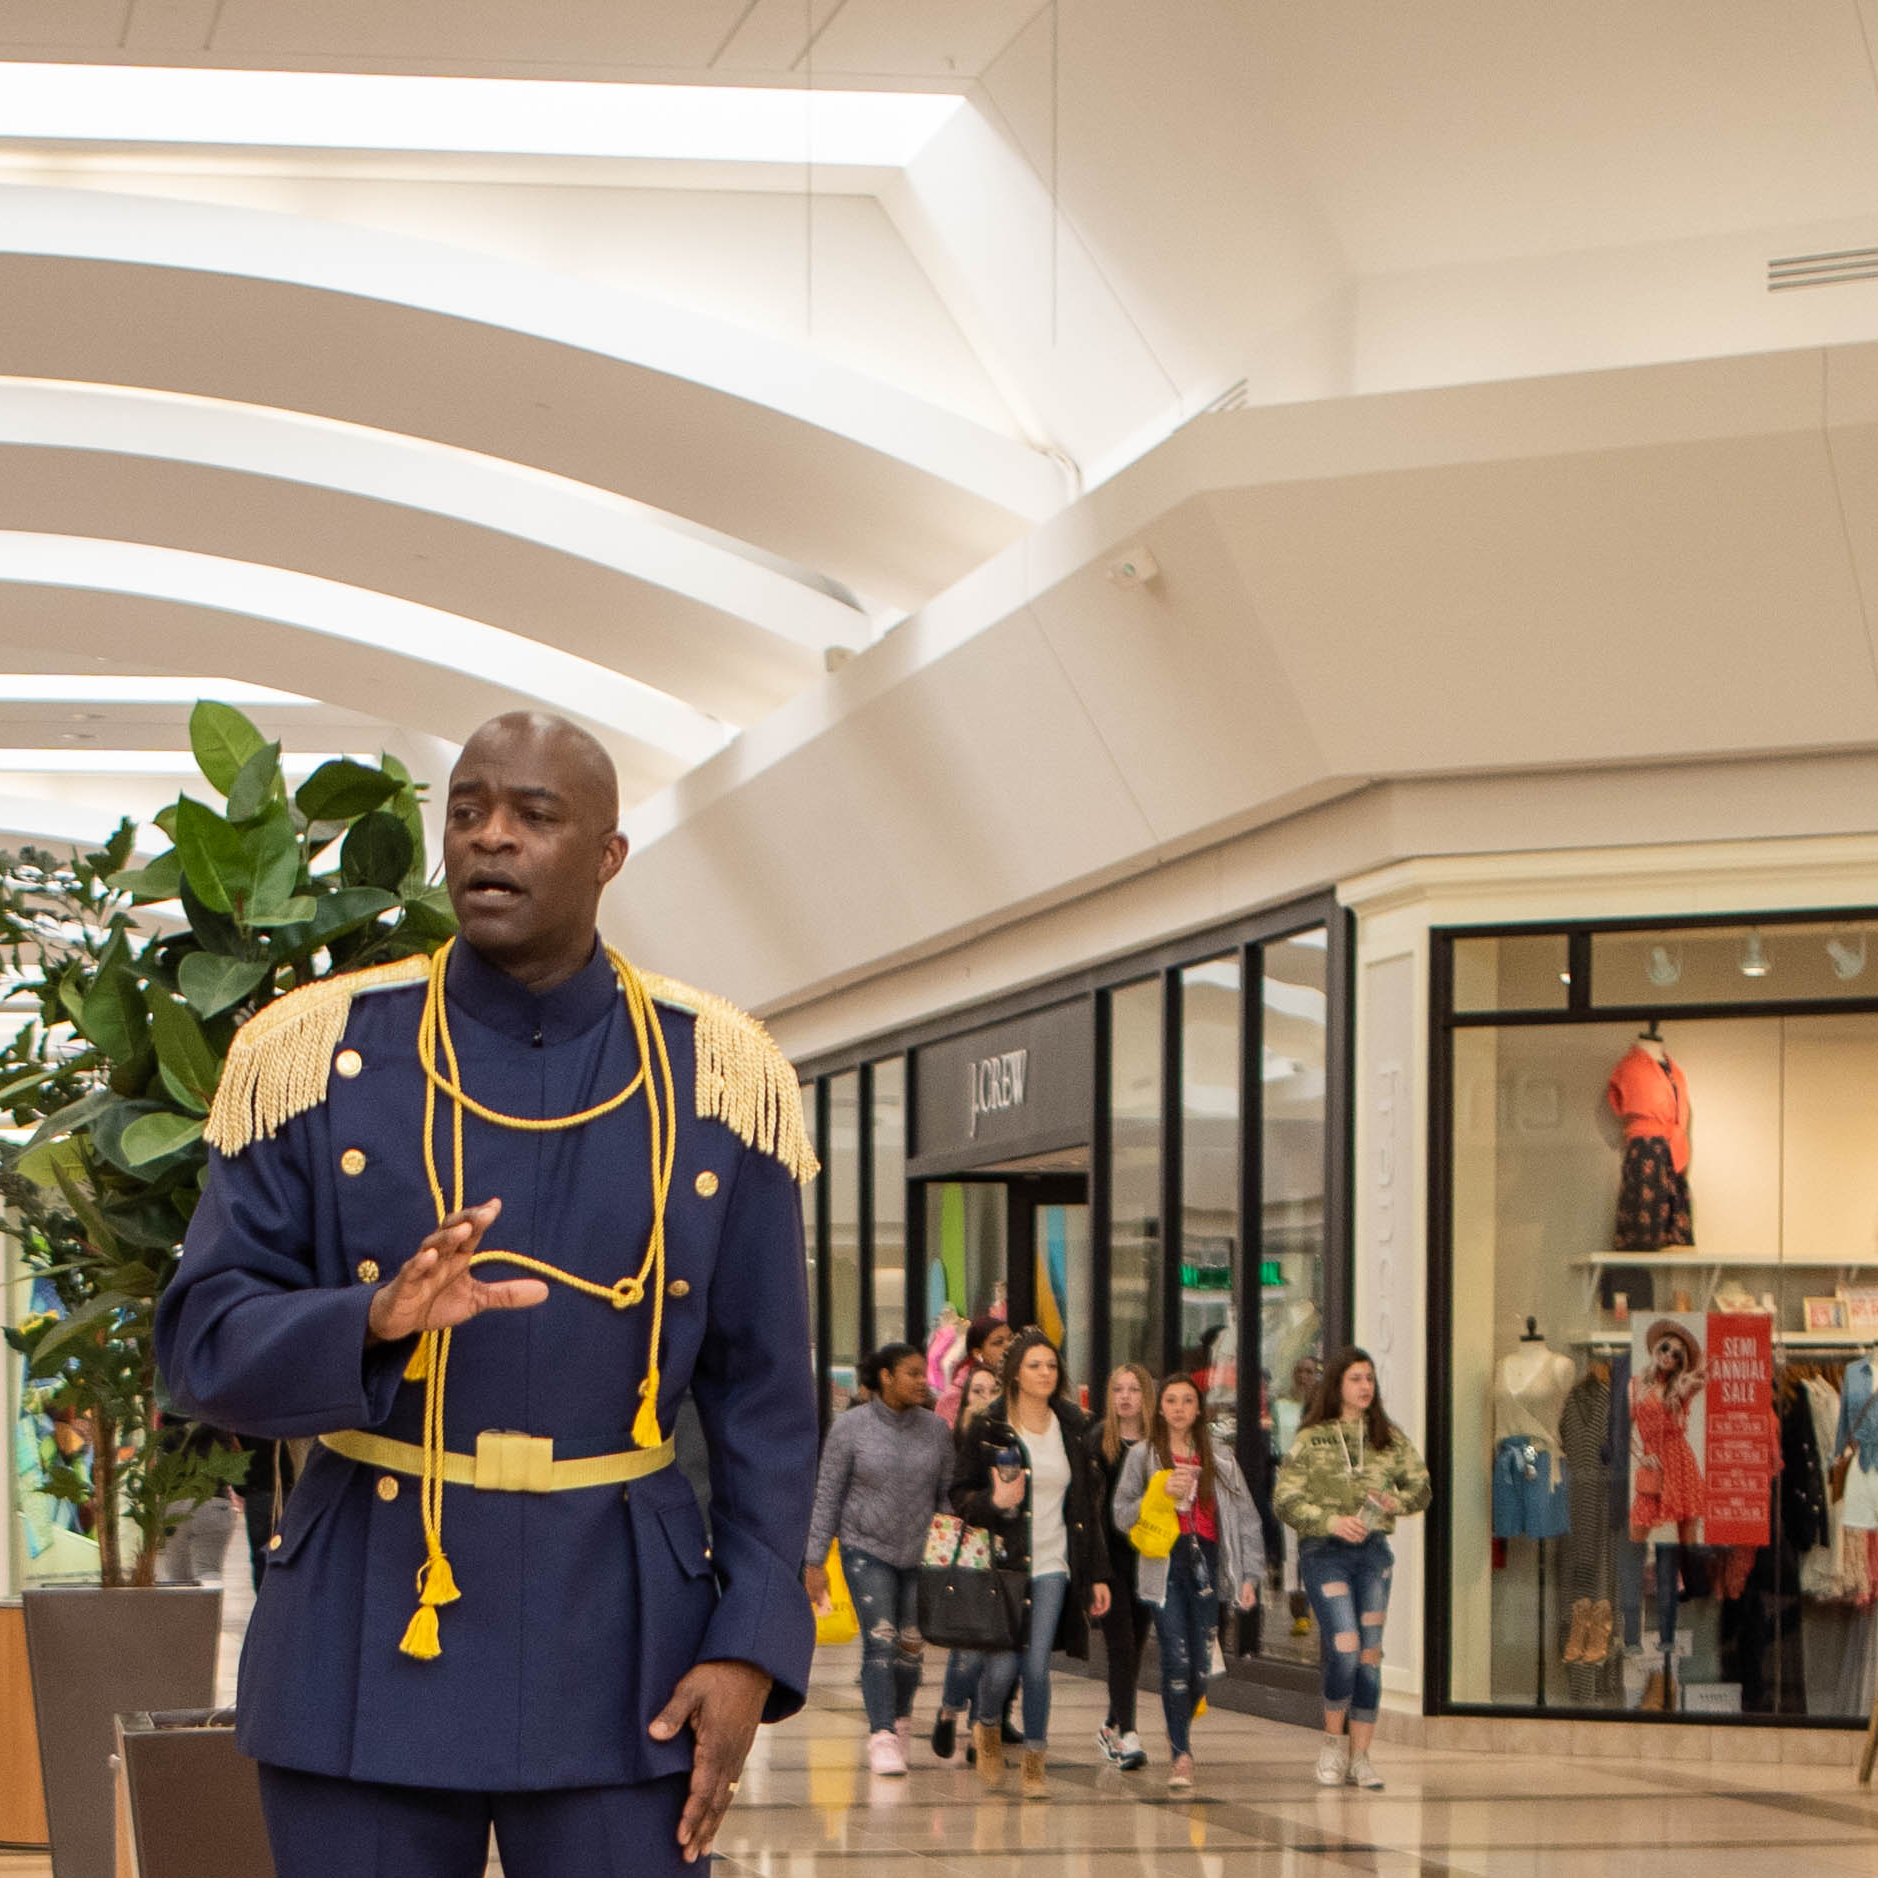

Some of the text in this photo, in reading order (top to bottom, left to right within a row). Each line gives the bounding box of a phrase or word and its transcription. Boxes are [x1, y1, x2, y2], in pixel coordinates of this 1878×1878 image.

[969, 1049, 1027, 1137] J.CREW
[1723, 1336, 1757, 1358] SEMI
[1710, 1358, 1766, 1380] ANNUAL
[1722, 1380, 1756, 1403] SALE
